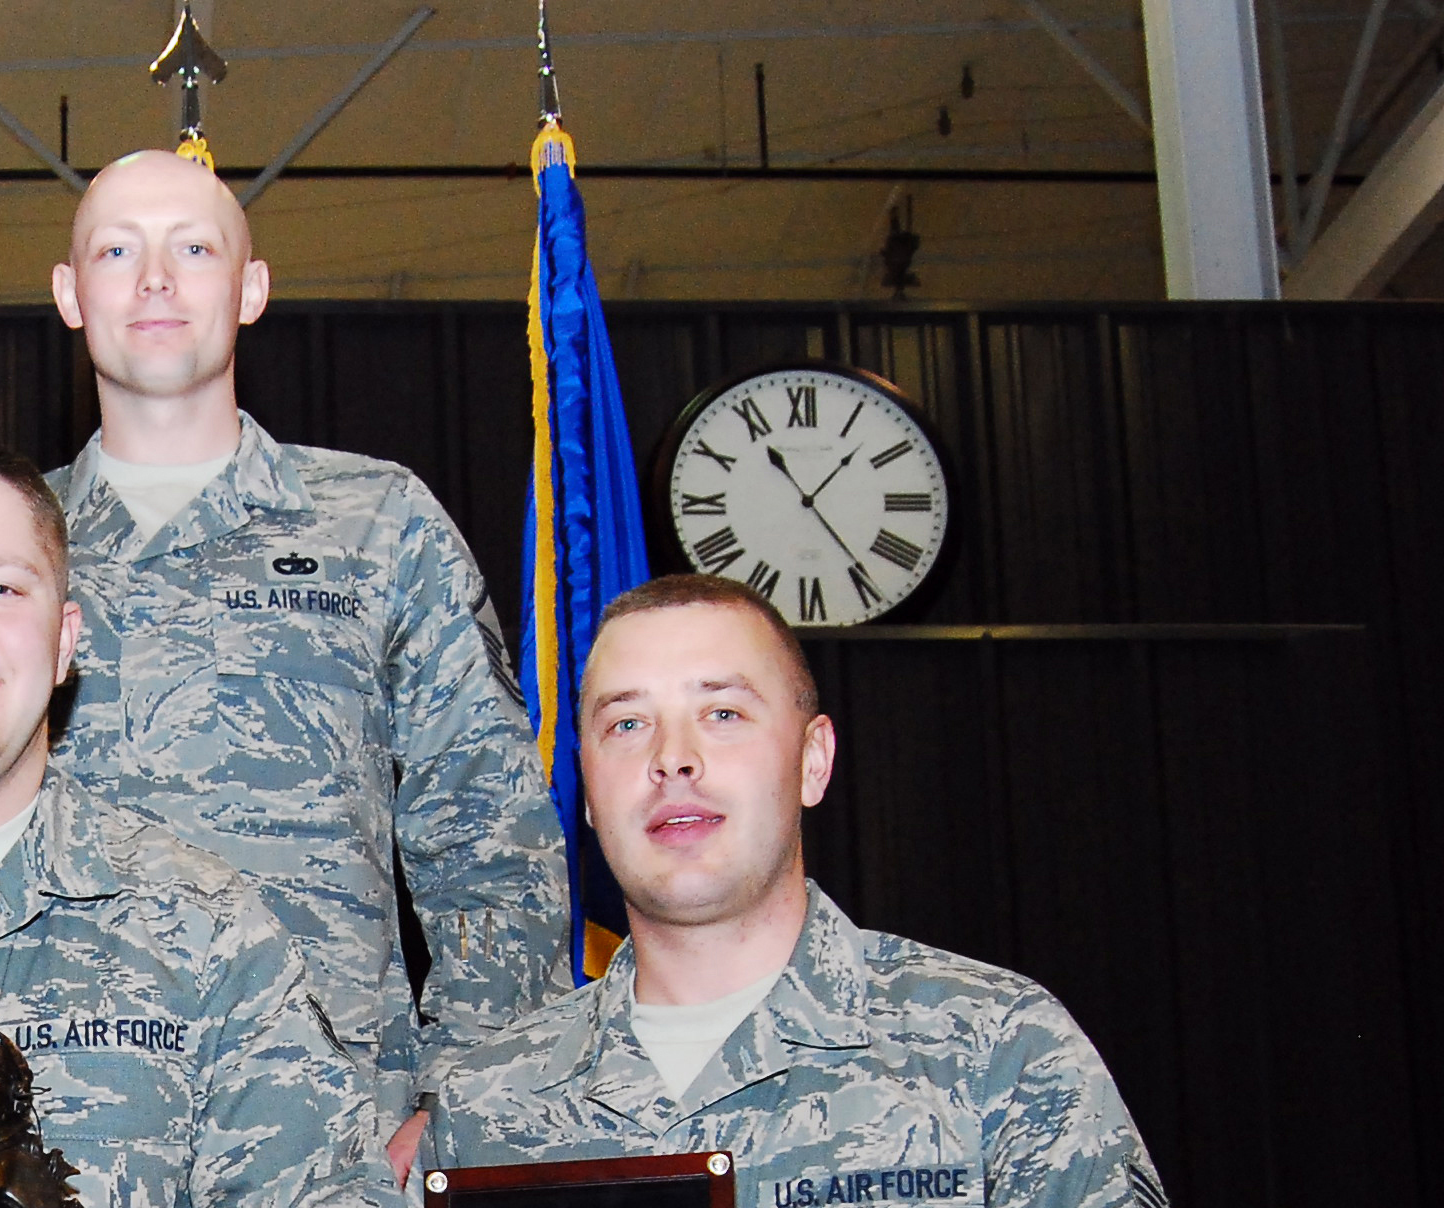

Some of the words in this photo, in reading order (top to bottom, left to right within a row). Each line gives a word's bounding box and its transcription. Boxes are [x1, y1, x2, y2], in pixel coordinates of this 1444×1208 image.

[731, 397, 773, 442] XI
[786, 386, 818, 428] XII
[692, 438, 738, 472] X
[868, 439, 914, 470] II
[681, 492, 727, 516] IX
[883, 493, 932, 512] III
[226, 589, 262, 610] U.S.
[267, 588, 302, 611] AIR
[306, 590, 362, 619] FORCE
[798, 576, 828, 622] VI
[15, 1023, 57, 1052] U.S.
[63, 1018, 110, 1048] AIR
[116, 1018, 190, 1053] FORCE
[826, 1173, 874, 1204] AIR
[880, 1168, 969, 1201] FORCE
